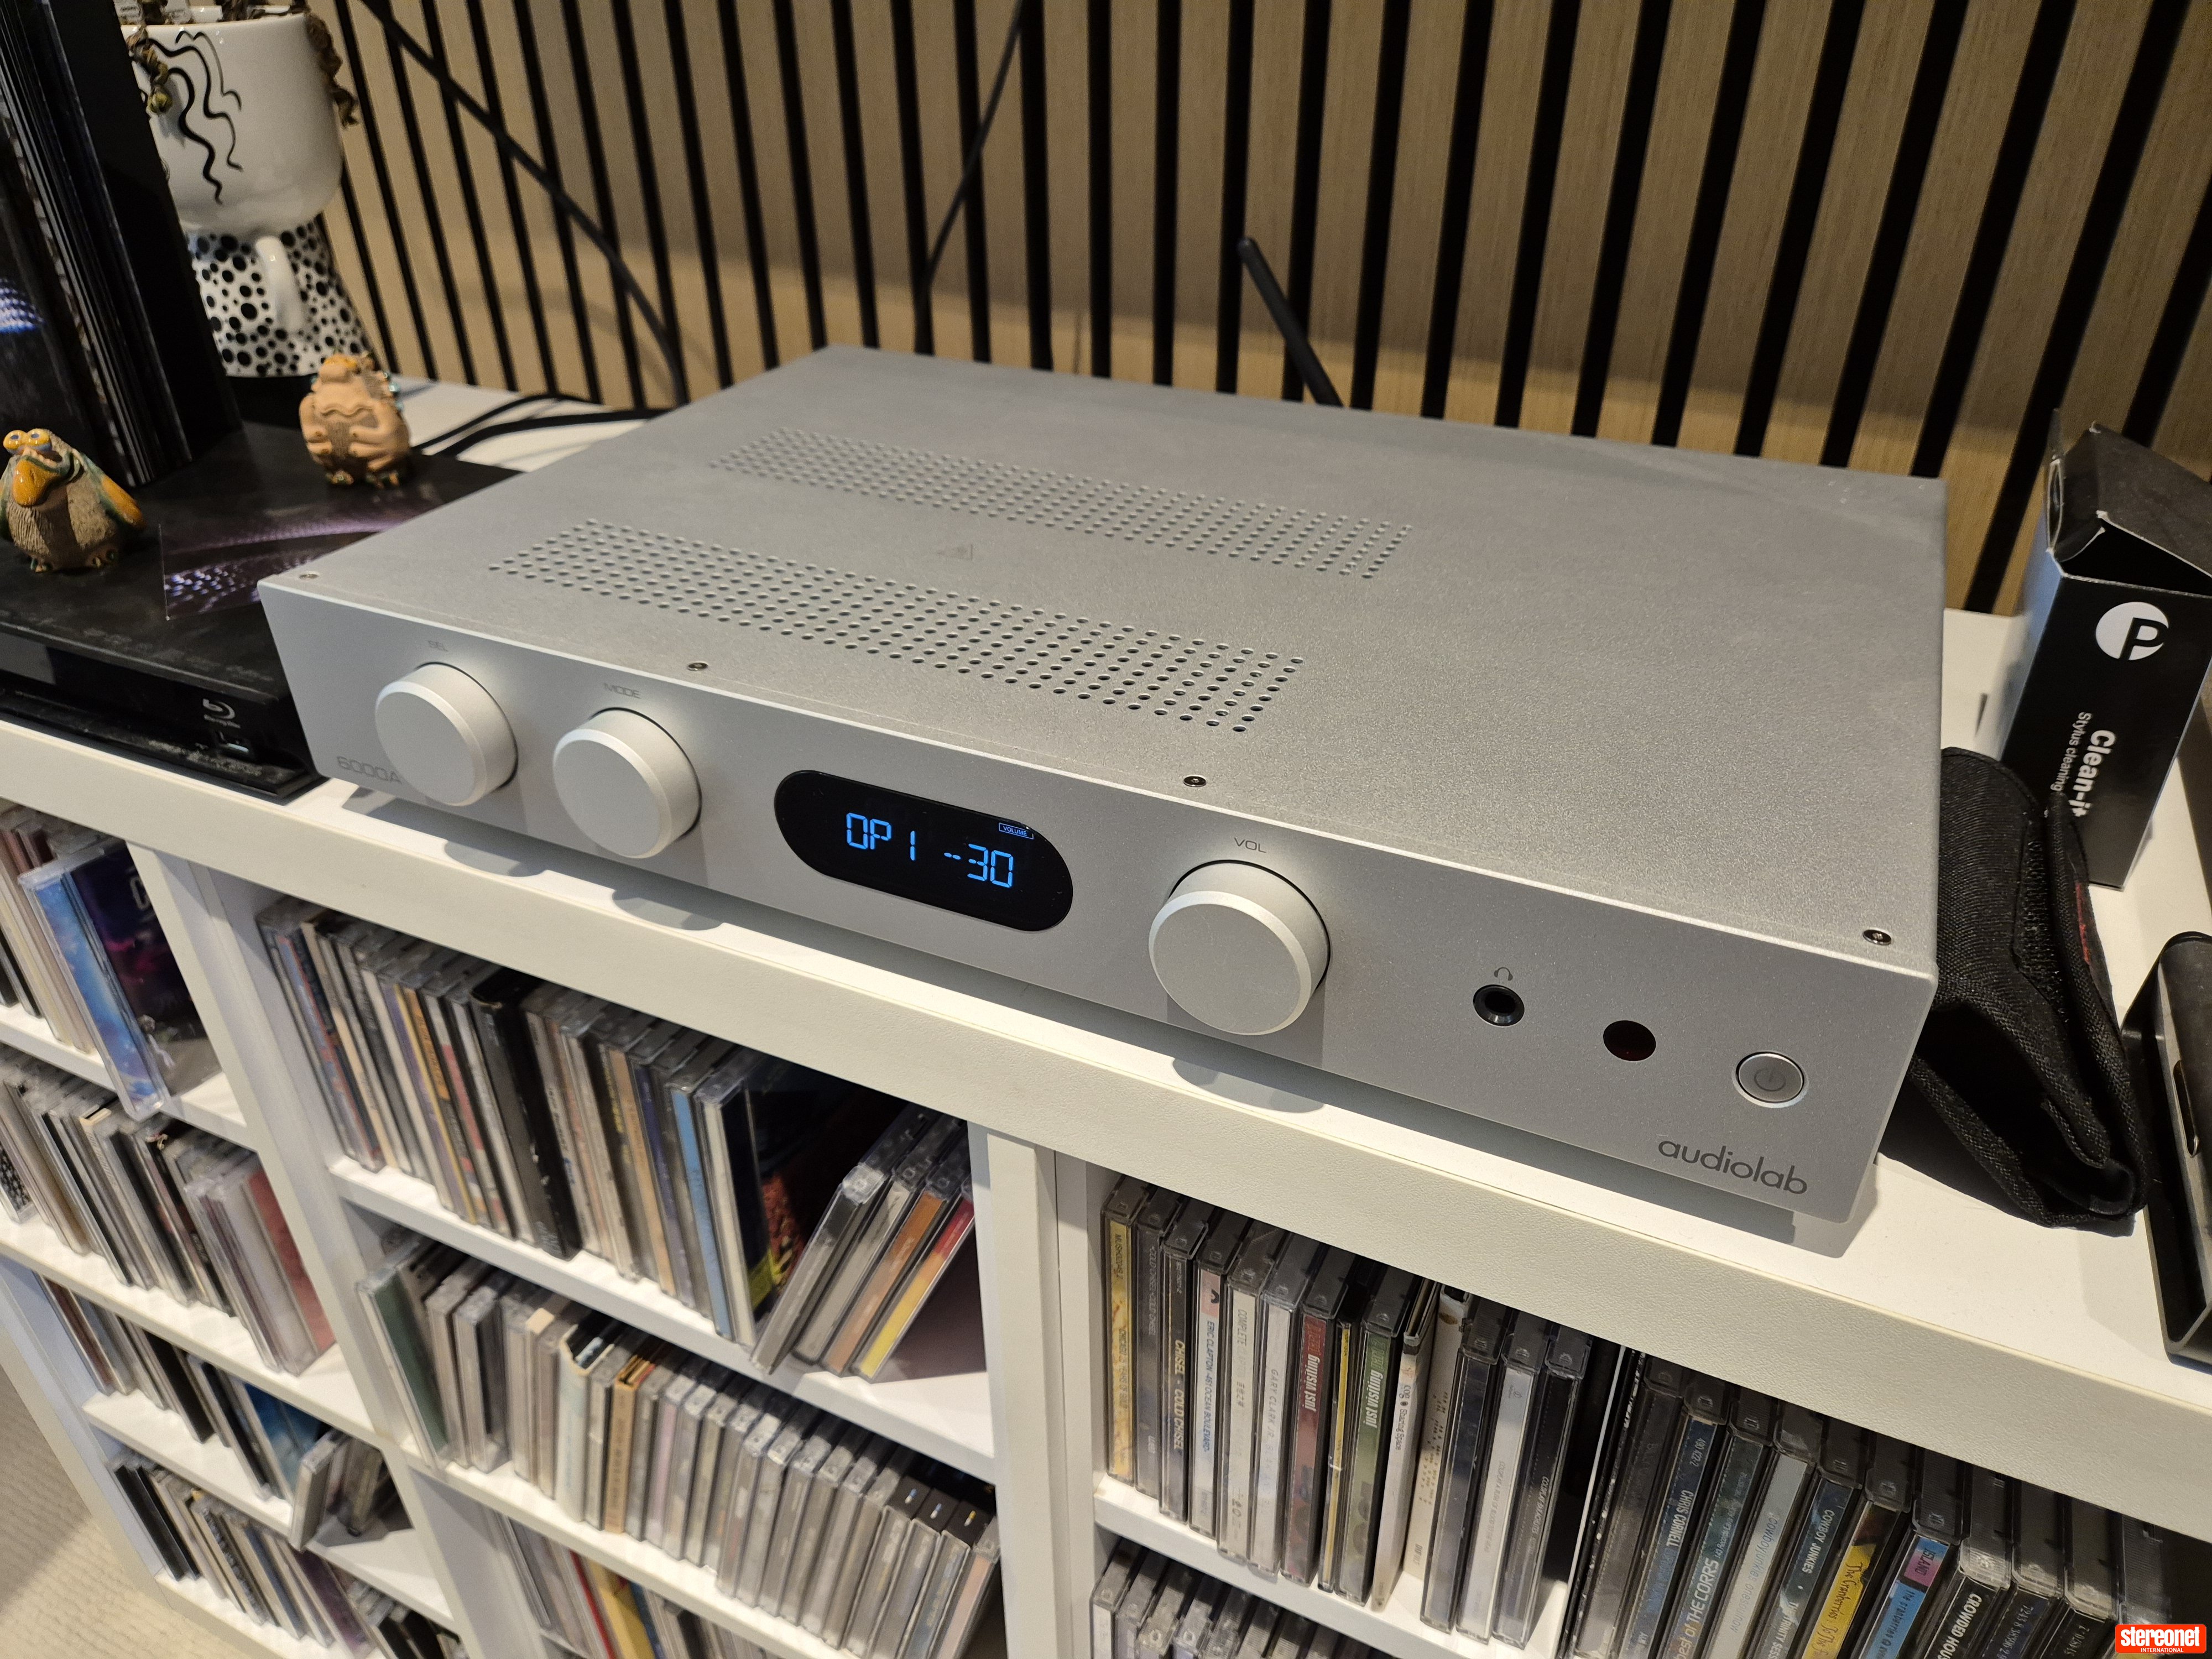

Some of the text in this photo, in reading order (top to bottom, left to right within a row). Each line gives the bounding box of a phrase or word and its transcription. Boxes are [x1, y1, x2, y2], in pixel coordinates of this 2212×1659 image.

[427, 640, 449, 652] SEL
[603, 682, 641, 698] MODE
[2051, 711, 2093, 791] Stylus cleaning
[336, 755, 403, 784] 6000A
[1003, 825, 1027, 837] VOLUME
[1234, 836, 1267, 853] VOL
[1657, 1138, 1808, 1196] audiolab
[1206, 1321, 1215, 1339] ERIC
[1237, 1309, 1248, 1345] COMPLETE
[1174, 1339, 1185, 1375] CHISEL
[1205, 1338, 1214, 1371] CLAPTON
[1269, 1369, 1279, 1394] GARY
[1304, 1354, 1320, 1389] visiting
[1203, 1386, 1212, 1410] OCEAN
[1302, 1390, 1316, 1412] just
[1365, 1369, 1383, 1407] visiting
[1173, 1389, 1184, 1417] COLD
[1267, 1395, 1277, 1423] CLARK
[1363, 1407, 1378, 1428] just
[1394, 1384, 1411, 1451] cog Sharing Space
[1172, 1417, 1183, 1450] CHISEL
[1689, 1438, 1707, 1467] 490 422-2
[1537, 1475, 1550, 1502] COLDPLAY
[1676, 1490, 1694, 1514] CHRIS
[1666, 1514, 1687, 1547] CORNELL
[1814, 1509, 1834, 1543] COWBOY
[1749, 1516, 1778, 1582] cowboyjunkies
[1802, 1542, 1822, 1574] JUNKIES
[1915, 1548, 1936, 1575] ISLAND
[1844, 1562, 1863, 1579] The
[1674, 1558, 1718, 1659] best of THE CORRS
[1903, 1590, 1915, 1601] the
[1775, 1614, 1793, 1643] TRINITY
[1821, 1624, 1838, 1635] To
[1885, 1600, 1908, 1639] cranberries
[1951, 1593, 1983, 1637] CROWDED
